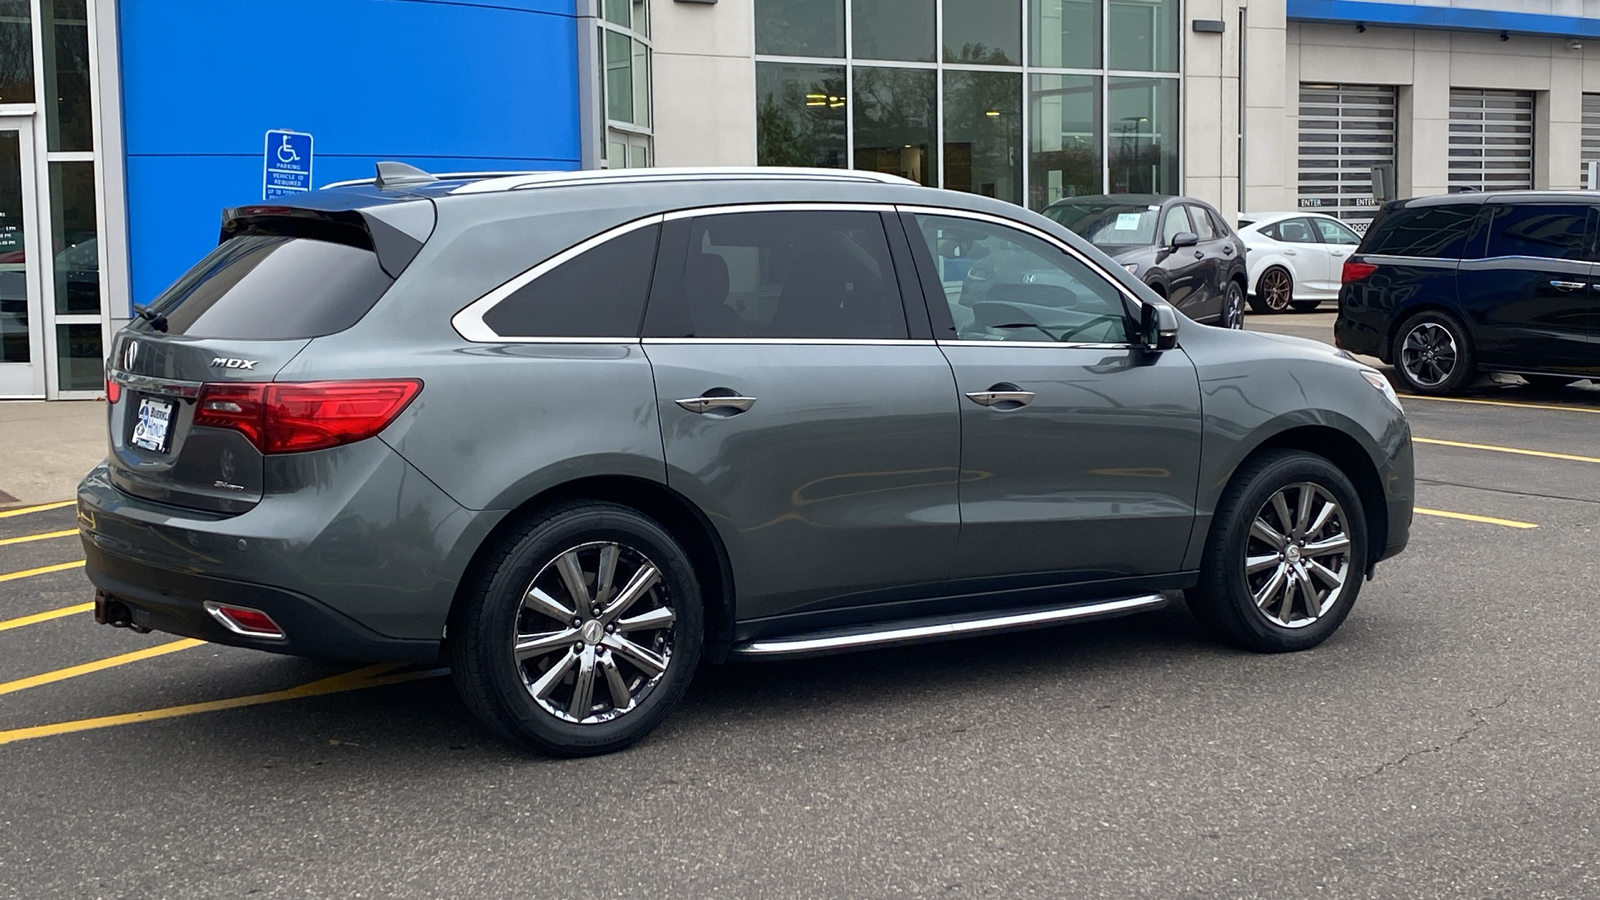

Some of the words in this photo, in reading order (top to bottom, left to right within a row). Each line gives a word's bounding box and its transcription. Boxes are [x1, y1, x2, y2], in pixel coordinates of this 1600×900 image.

[274, 179, 302, 187] REQUIRED
[1301, 199, 1322, 207] ENTER
[1353, 223, 1370, 231] DOO
[210, 357, 259, 370] MDX
